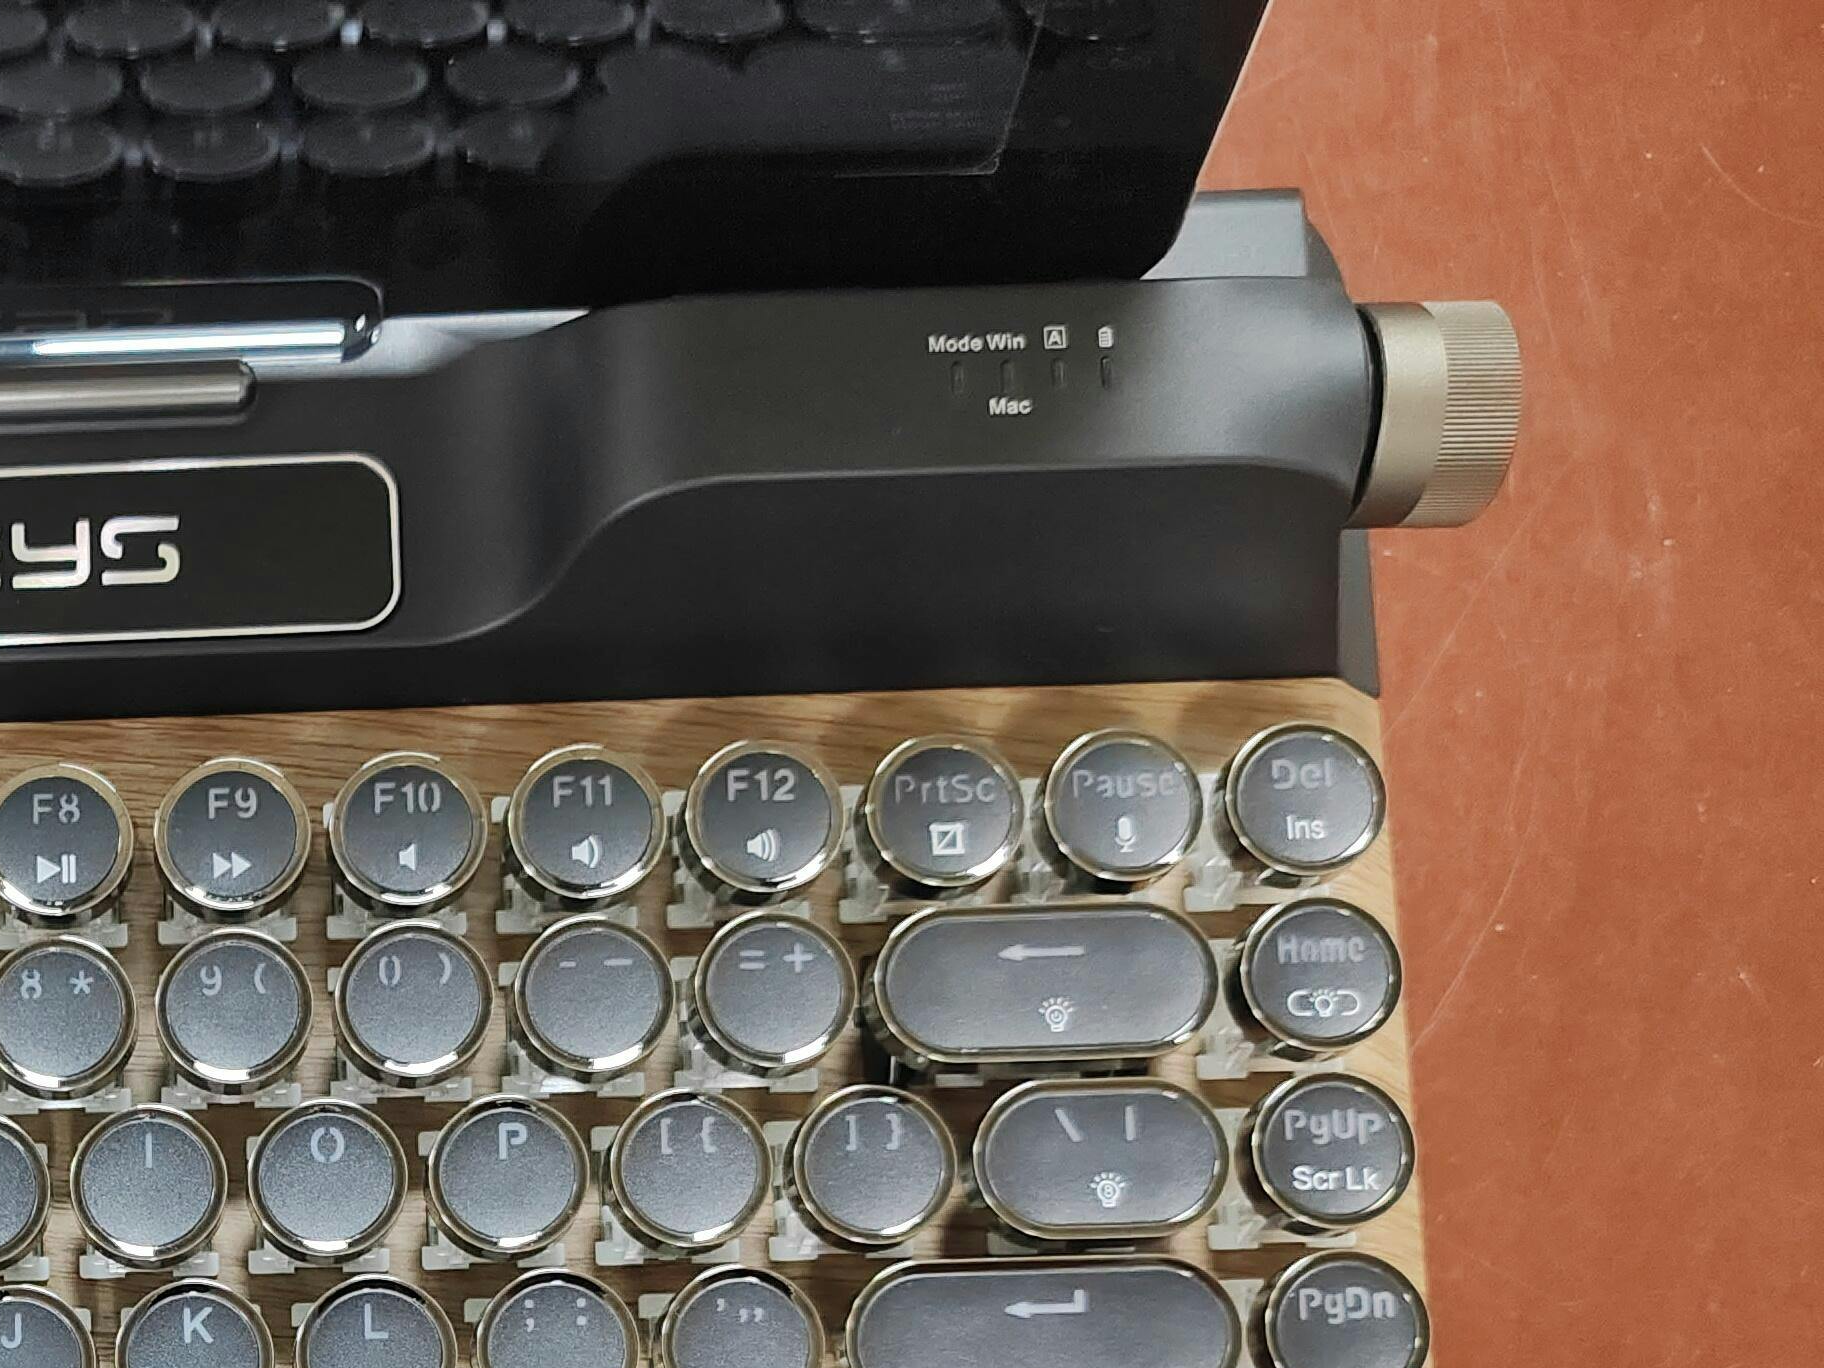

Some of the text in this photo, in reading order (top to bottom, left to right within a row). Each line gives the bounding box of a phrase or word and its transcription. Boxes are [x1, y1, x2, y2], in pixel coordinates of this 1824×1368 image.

[929, 334, 1025, 352] Mode Win
[989, 398, 1031, 414] Mac
[728, 769, 795, 801] F12
[896, 774, 998, 805] PrtSc
[1073, 769, 1176, 799] Pause
[1272, 759, 1335, 791] Del
[209, 788, 257, 819] F9
[375, 783, 441, 814] F10
[554, 776, 612, 807] F11
[33, 794, 80, 824] F8
[1287, 816, 1329, 839] Ins
[1279, 936, 1365, 966] Home
[21, 971, 42, 1000] 8
[200, 966, 222, 996] 9
[379, 956, 401, 986] 0
[499, 1123, 527, 1159] P
[1285, 1109, 1385, 1145] PgUp
[310, 1128, 345, 1163] O
[1300, 1287, 1396, 1324] PgDn
[1, 1313, 22, 1349] J
[183, 1307, 213, 1343] K
[364, 1304, 389, 1340] L
